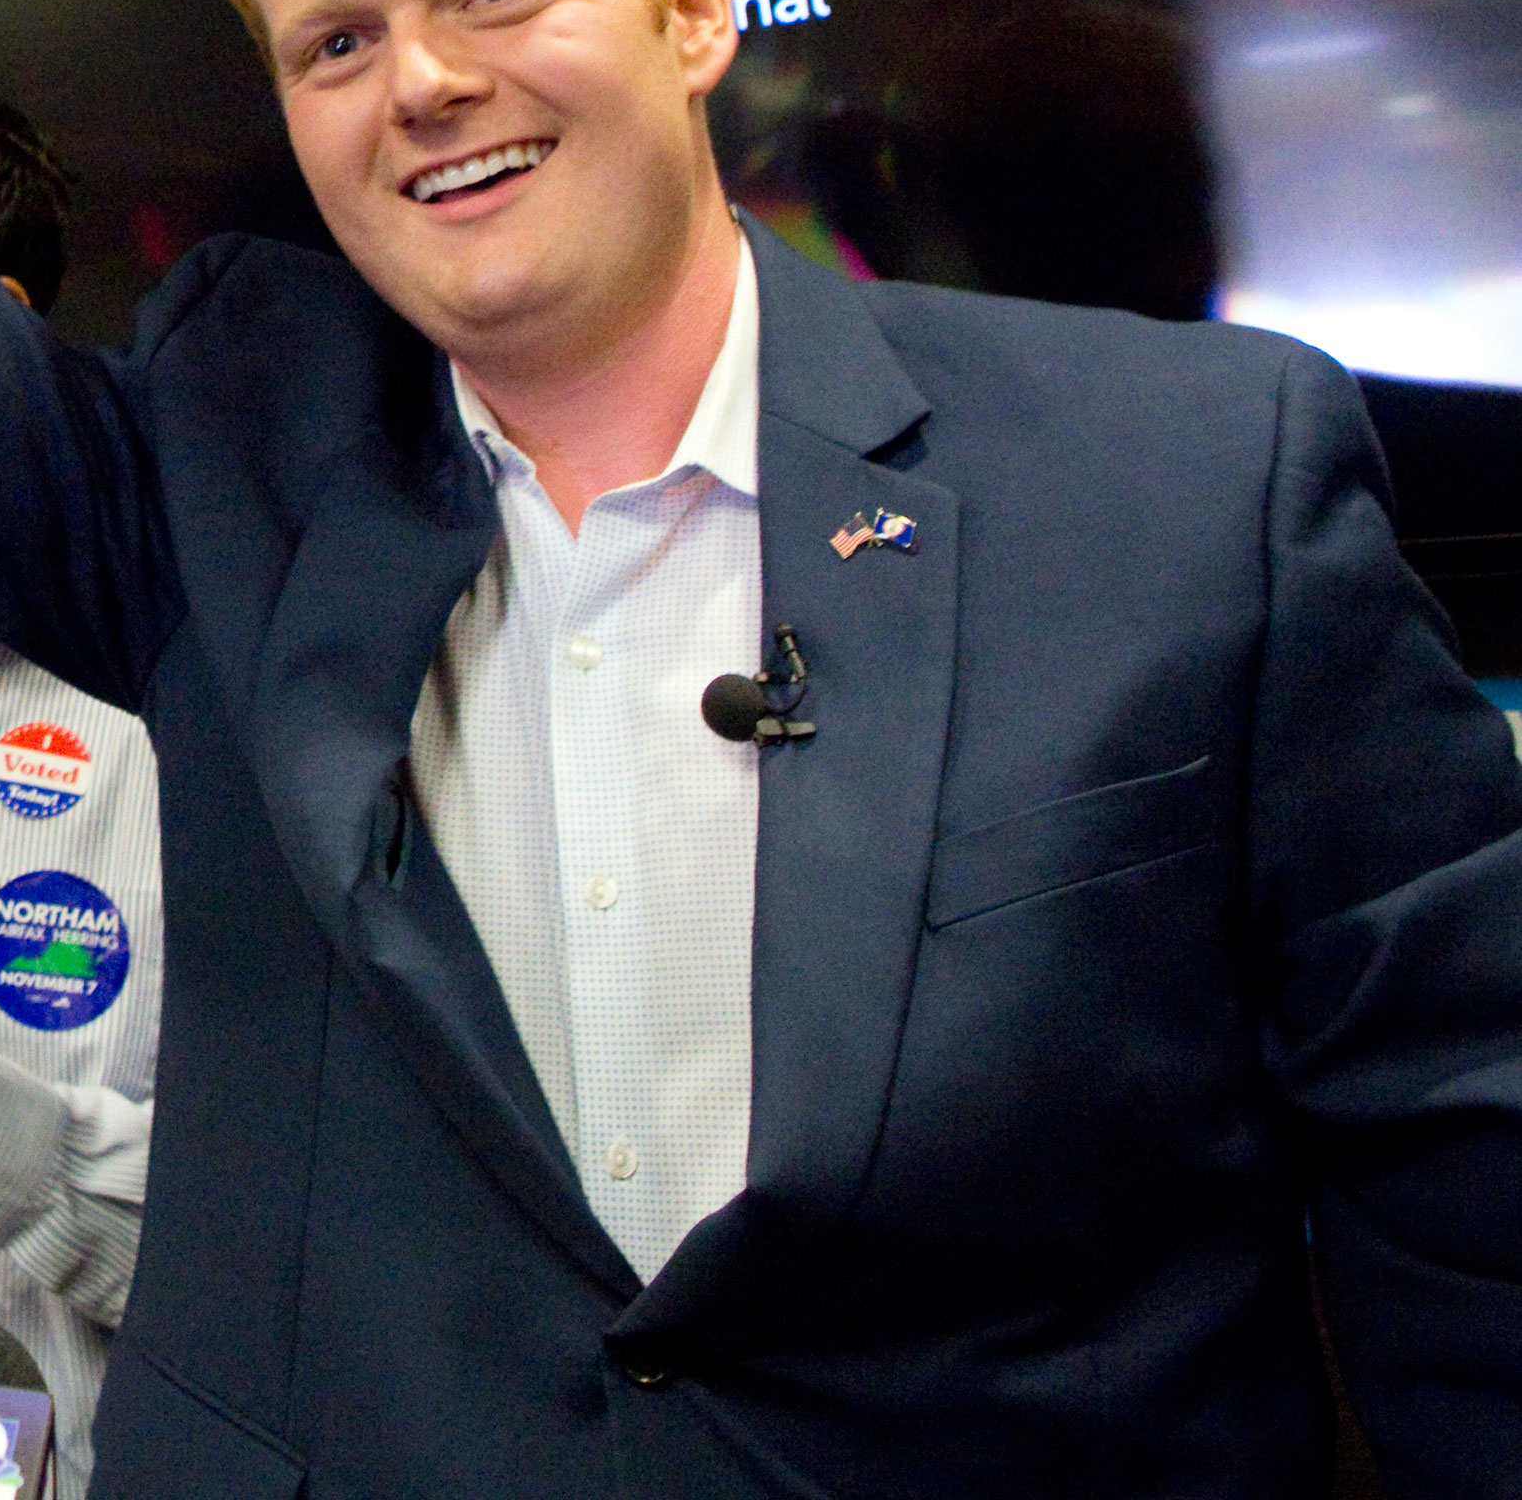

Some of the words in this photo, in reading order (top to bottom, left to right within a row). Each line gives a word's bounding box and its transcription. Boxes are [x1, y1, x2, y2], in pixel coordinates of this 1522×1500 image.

[5, 753, 80, 785] Voted
[0, 969, 85, 994] NOVEMBER
[85, 980, 99, 996] 7
